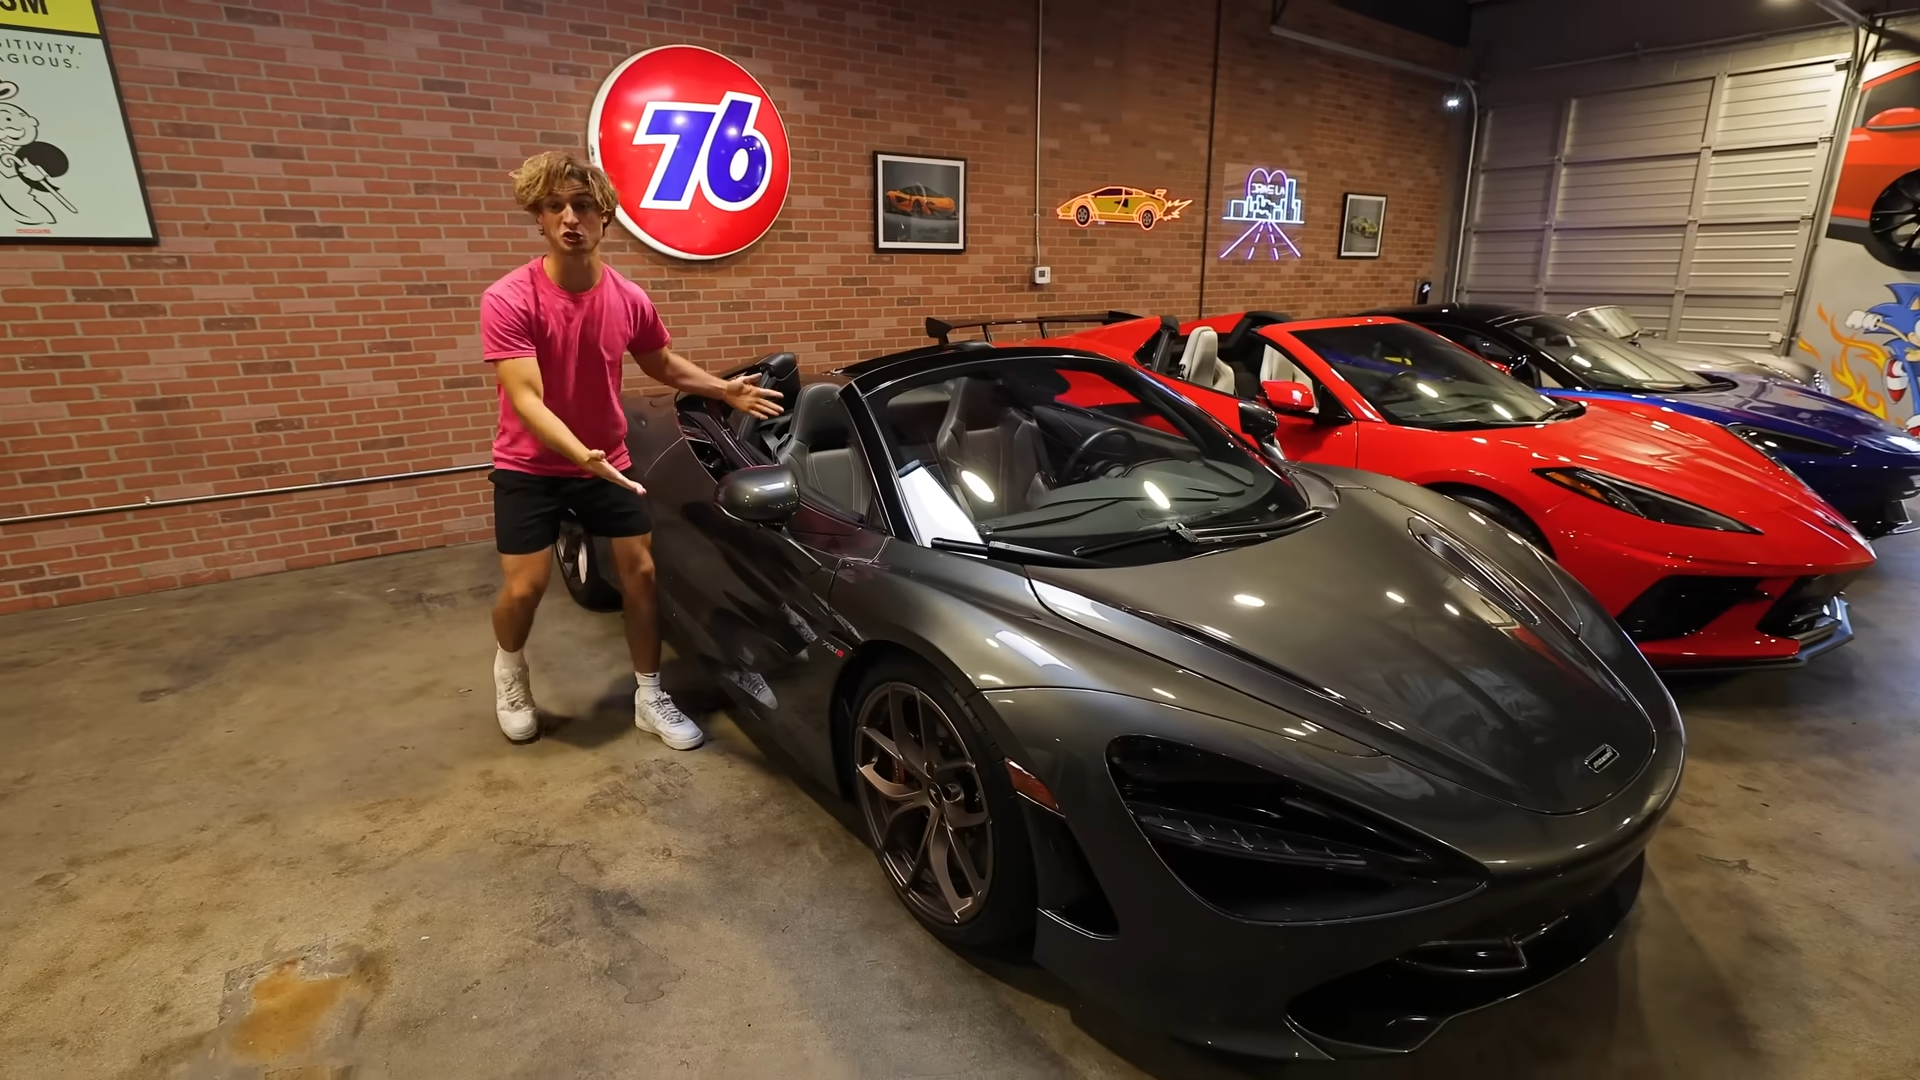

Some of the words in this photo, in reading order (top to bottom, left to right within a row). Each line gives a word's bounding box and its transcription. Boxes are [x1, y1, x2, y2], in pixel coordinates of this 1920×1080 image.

[0, 38, 82, 55] ITIVITY.
[0, 53, 80, 69] GIOUS.
[632, 90, 773, 212] 76
